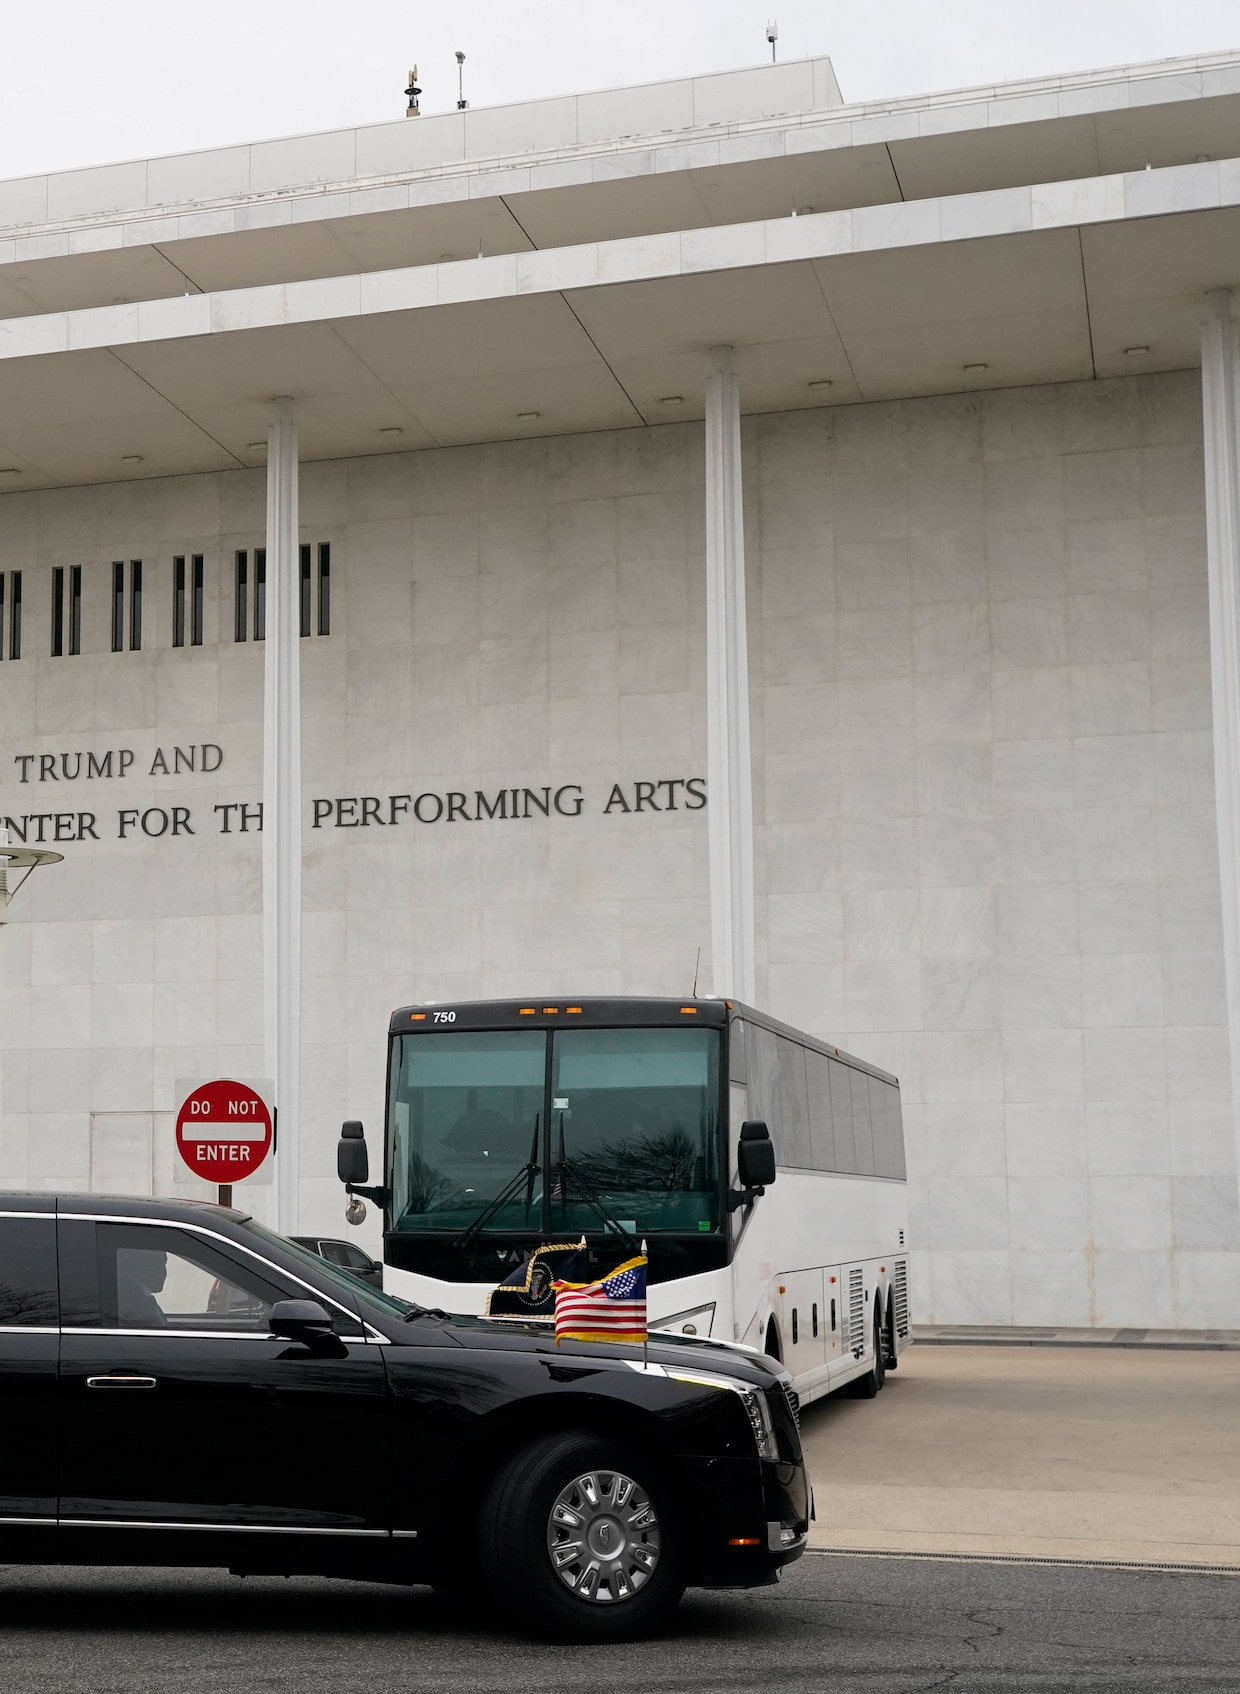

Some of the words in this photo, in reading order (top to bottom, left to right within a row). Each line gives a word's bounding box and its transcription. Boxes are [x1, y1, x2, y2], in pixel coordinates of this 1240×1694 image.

[14, 750, 135, 783] TRUMP
[148, 744, 223, 775] AND
[117, 806, 196, 838] FOR
[213, 802, 264, 833] TH
[311, 784, 585, 828] PERFORMING
[602, 777, 708, 814] ARTS
[432, 1011, 457, 1024] 750
[190, 1101, 211, 1115] DO
[228, 1101, 258, 1115] NOT
[196, 1145, 251, 1161] ENTER
